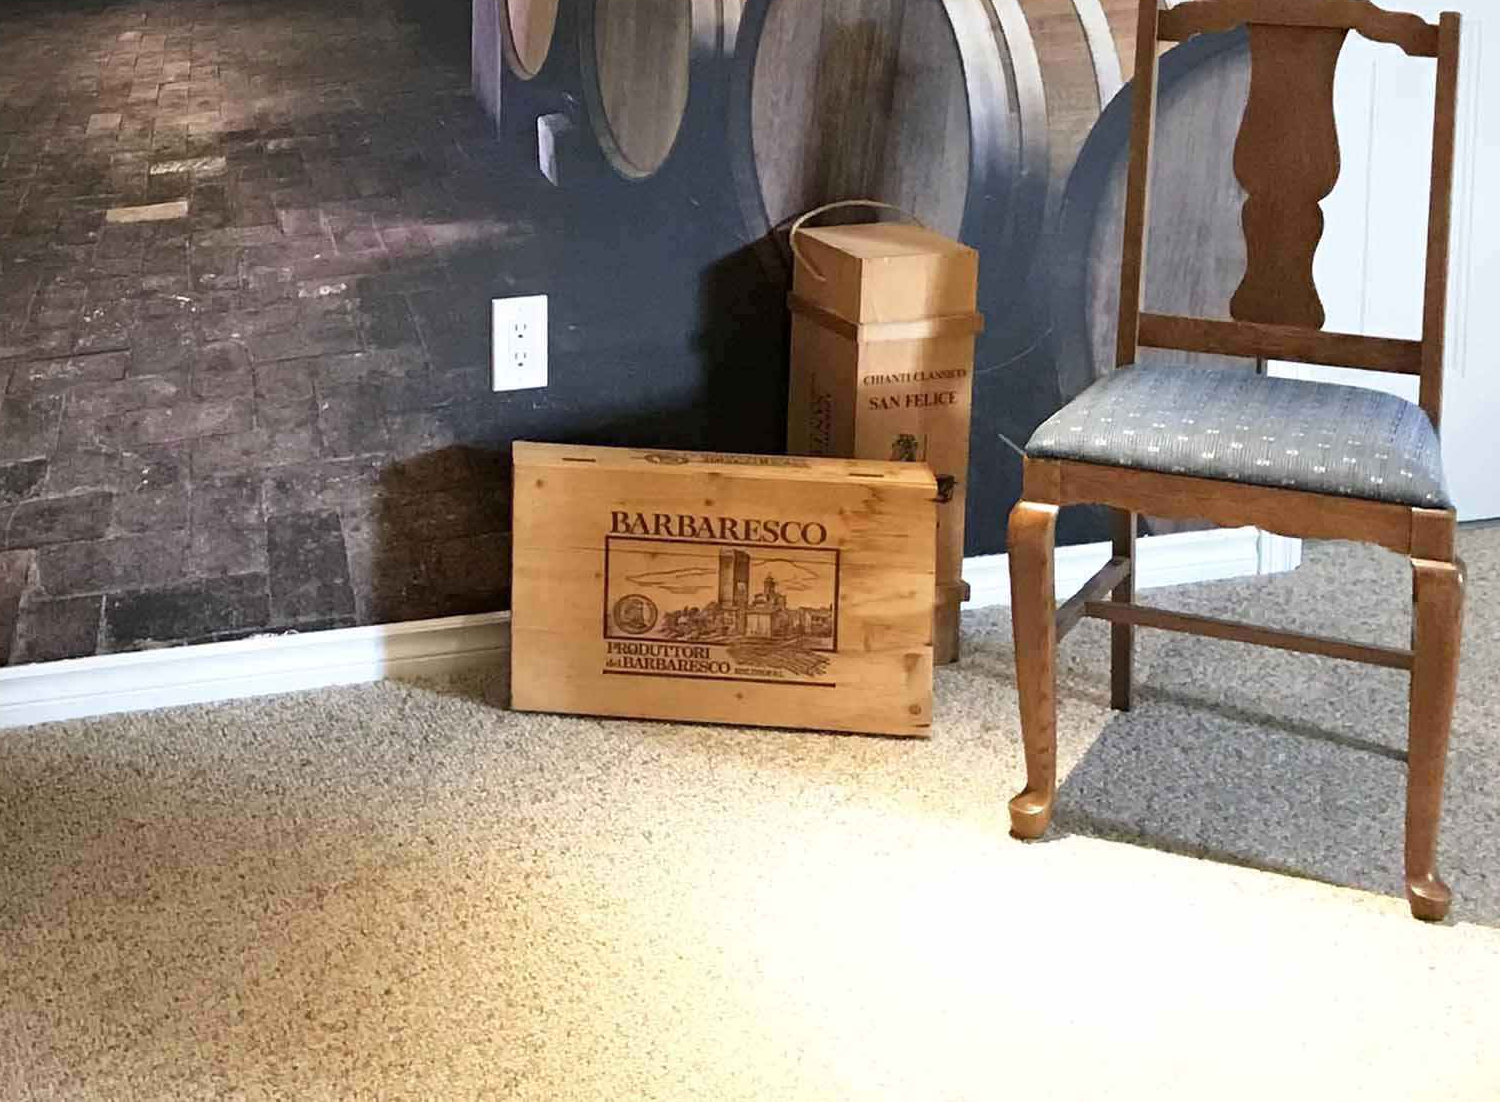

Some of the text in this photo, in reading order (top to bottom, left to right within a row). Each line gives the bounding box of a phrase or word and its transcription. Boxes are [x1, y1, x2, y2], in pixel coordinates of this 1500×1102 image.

[863, 373, 910, 386] CHIANTI
[869, 391, 957, 410] SAN FELICE
[609, 511, 828, 545] BARBARESCO
[606, 641, 711, 659] PRODUTTORI
[623, 656, 731, 675] BARBARESCO
